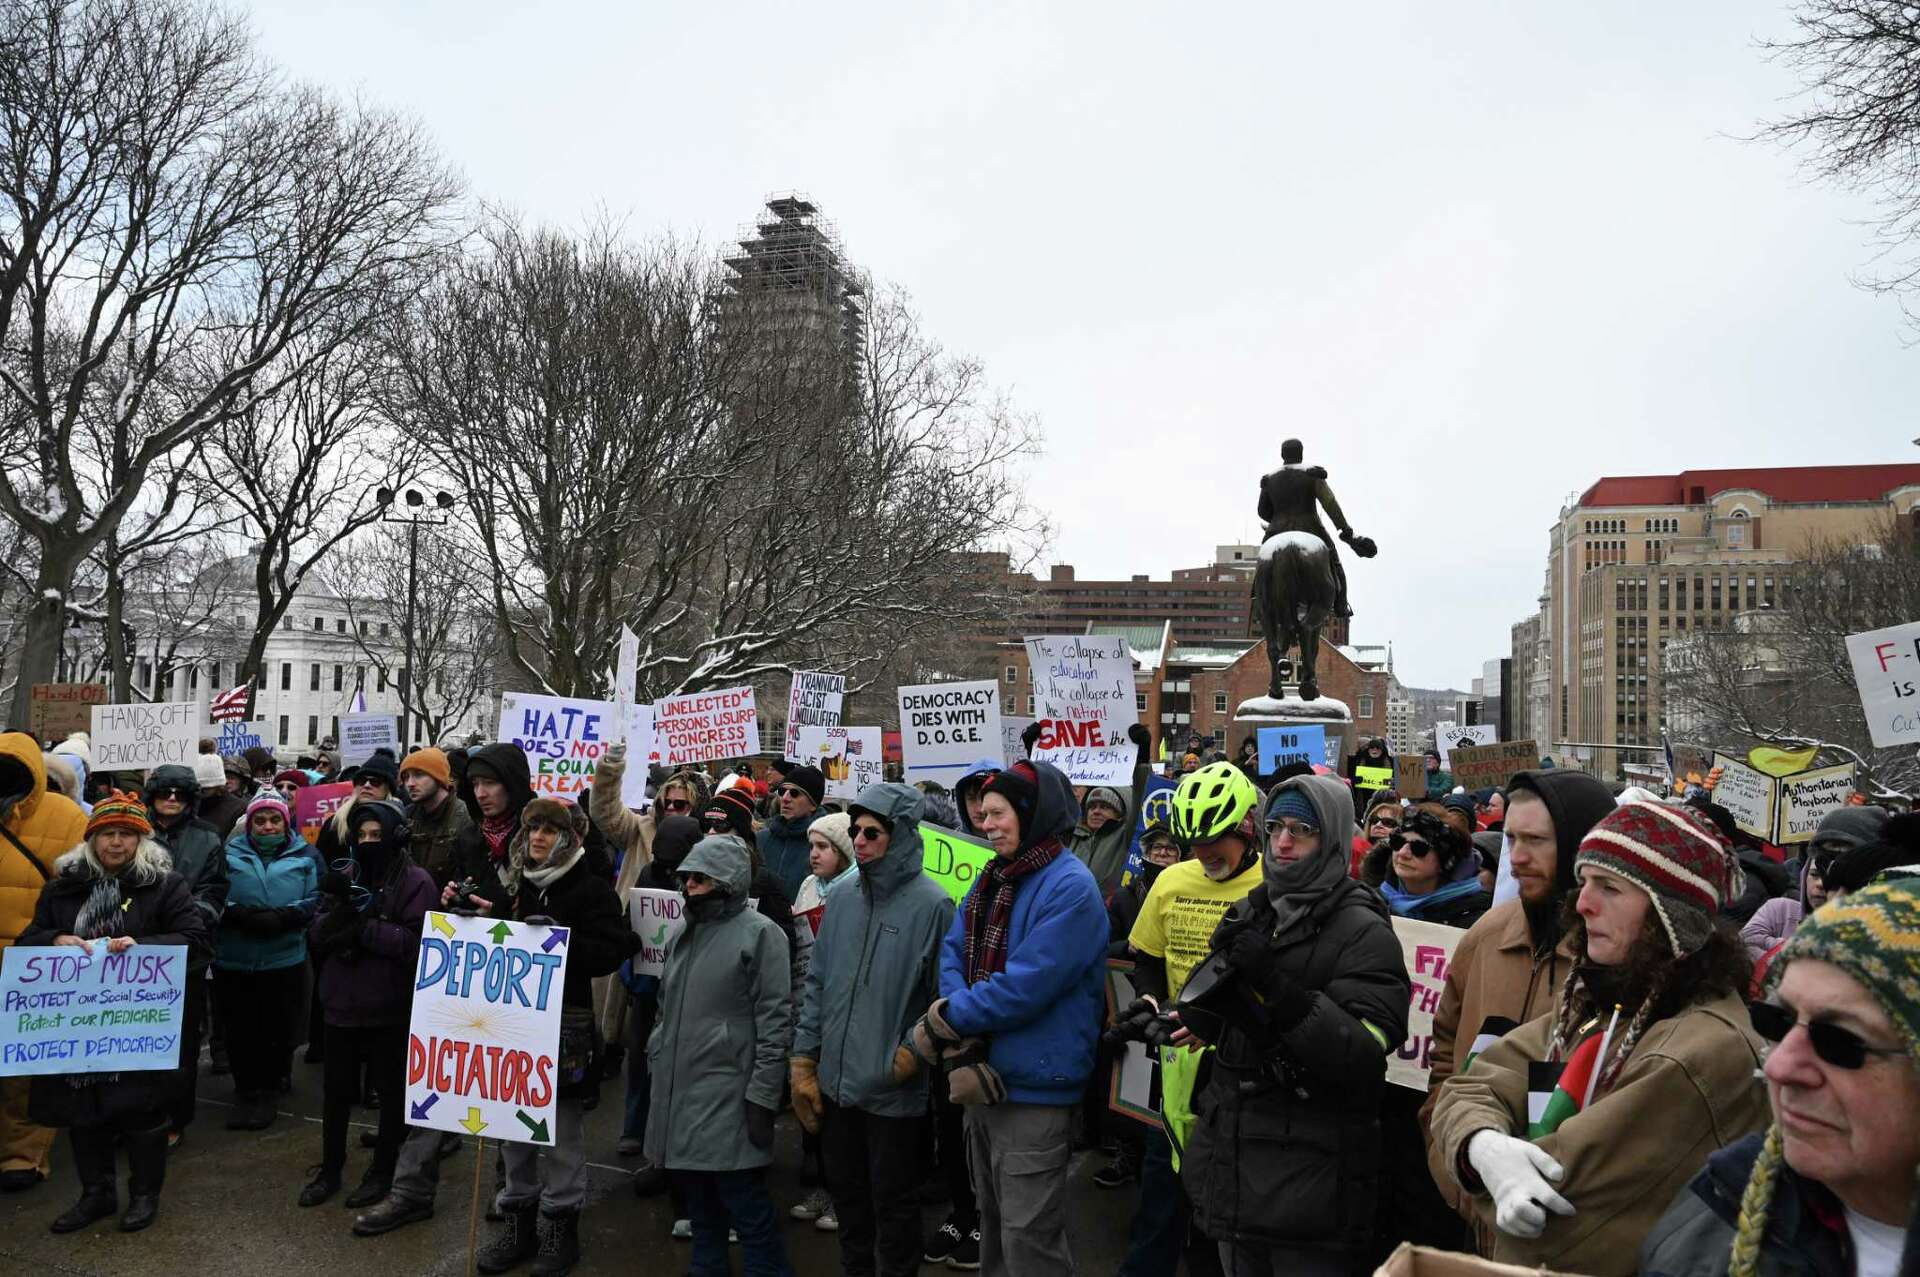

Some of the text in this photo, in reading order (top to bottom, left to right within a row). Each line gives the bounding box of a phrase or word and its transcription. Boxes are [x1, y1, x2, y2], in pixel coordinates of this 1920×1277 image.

[1026, 638, 1124, 668] The collapse of
[1050, 660, 1099, 680] education
[795, 672, 845, 694] TYRANNICAL
[1050, 678, 1065, 699] the
[1070, 682, 1109, 706] collapse
[1112, 680, 1125, 700] of
[1892, 681, 1915, 698] is
[662, 693, 741, 717] UNELECTED
[792, 690, 828, 710] RACIST
[903, 690, 994, 710] DEMOCRACY
[101, 706, 153, 731] HANDS
[160, 703, 194, 726] OFF
[790, 707, 841, 728] UNQUALIFIED
[912, 709, 985, 727] DIES WITH
[1045, 701, 1108, 721] the nation!
[223, 722, 247, 736] NO
[523, 707, 601, 741] HATE
[656, 709, 757, 735] PERSONS USURP
[135, 726, 164, 741] OUR
[216, 734, 262, 750] ICTATOR
[669, 726, 745, 748] CONGRESS
[1037, 719, 1105, 749] SAVE
[1110, 731, 1125, 746] the
[1281, 734, 1298, 748] NO
[1445, 727, 1486, 742] RESIST!
[669, 741, 747, 764] AUTHORITY
[804, 755, 817, 767] WE
[539, 758, 597, 776] EQUA
[855, 760, 881, 776] SERVE
[1401, 761, 1423, 776] WTF
[858, 774, 870, 785] NO
[1782, 777, 1853, 798] Authoritarian
[1791, 792, 1841, 808] Playbook
[640, 896, 682, 920] FUND
[1175, 896, 1191, 905] Sorry
[18, 955, 174, 985] STOP MUSK
[415, 937, 562, 1011] DEPORT
[5, 990, 77, 1012] PROTECT
[100, 989, 132, 1005] Social
[18, 1012, 66, 1033] Protect
[100, 1008, 172, 1027] MEDICARE
[3, 1034, 177, 1063] PROTECT DEMOCRACY
[409, 1033, 553, 1107] DICTATORS
